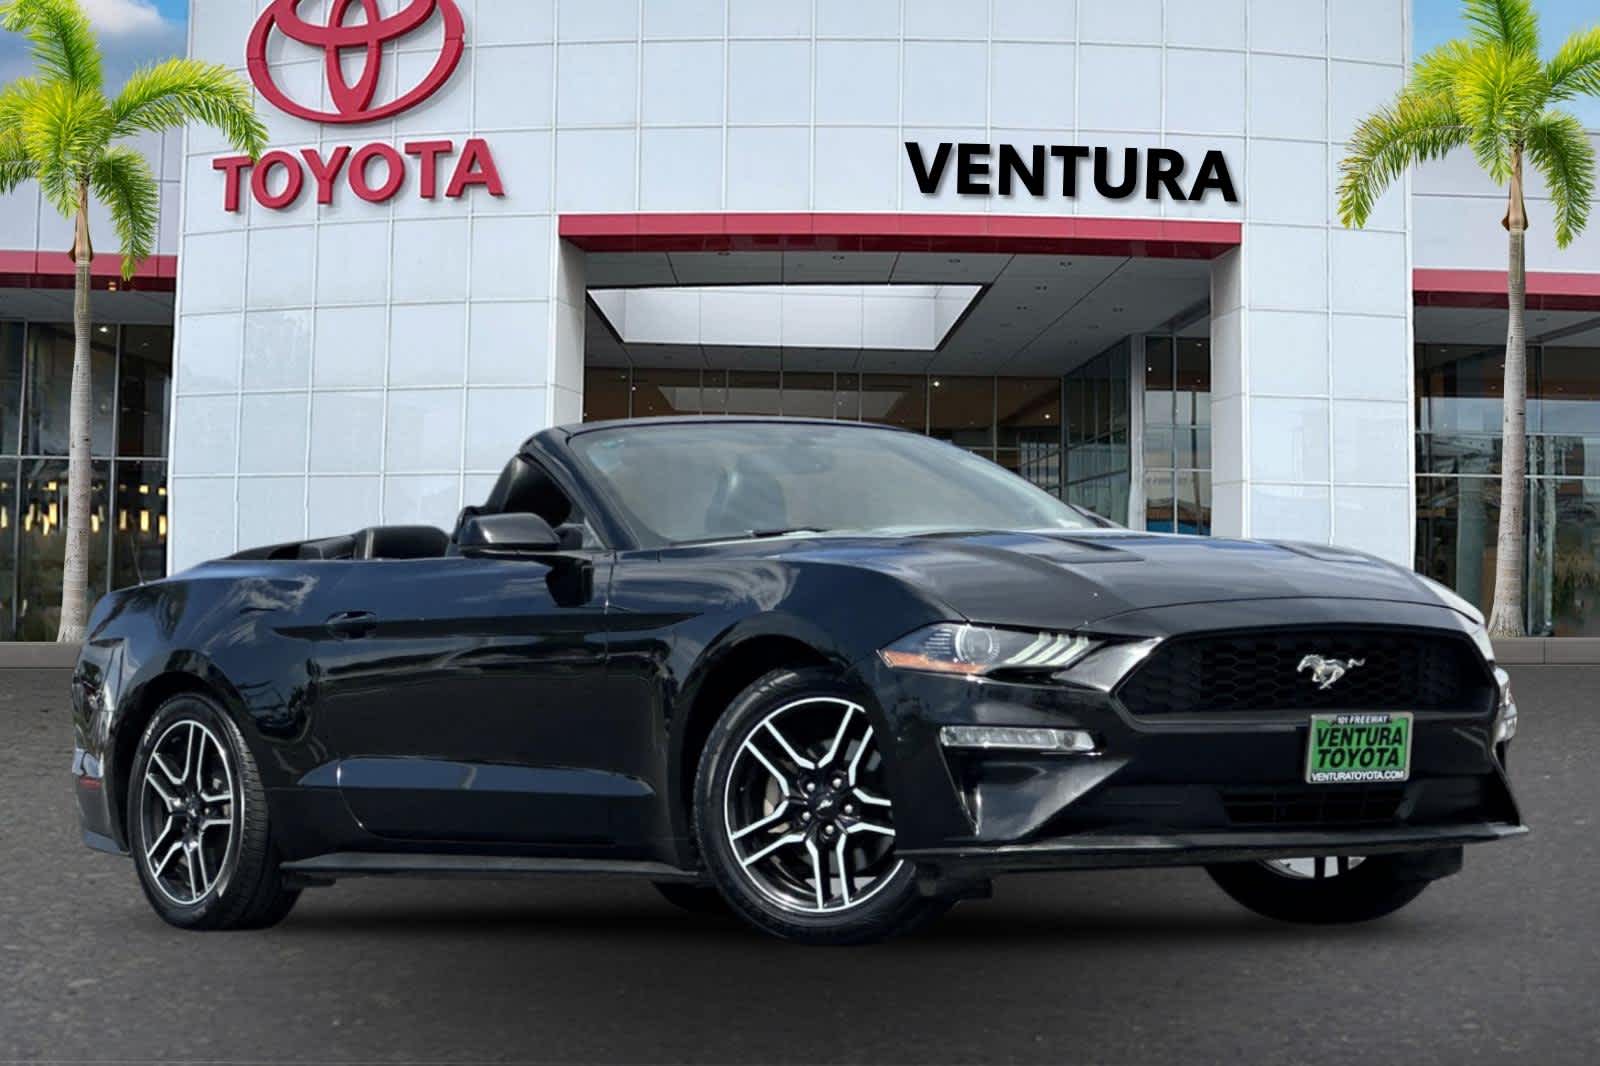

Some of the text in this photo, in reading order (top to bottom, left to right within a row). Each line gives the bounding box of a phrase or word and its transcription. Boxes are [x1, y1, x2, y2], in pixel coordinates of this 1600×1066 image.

[212, 138, 505, 212] TOYOTA
[904, 142, 1238, 202] VENTURA
[1316, 727, 1403, 747] VENTURA
[1317, 747, 1399, 768] TOYOTA
[1311, 770, 1404, 782] VENTURATOYOTA.COM
